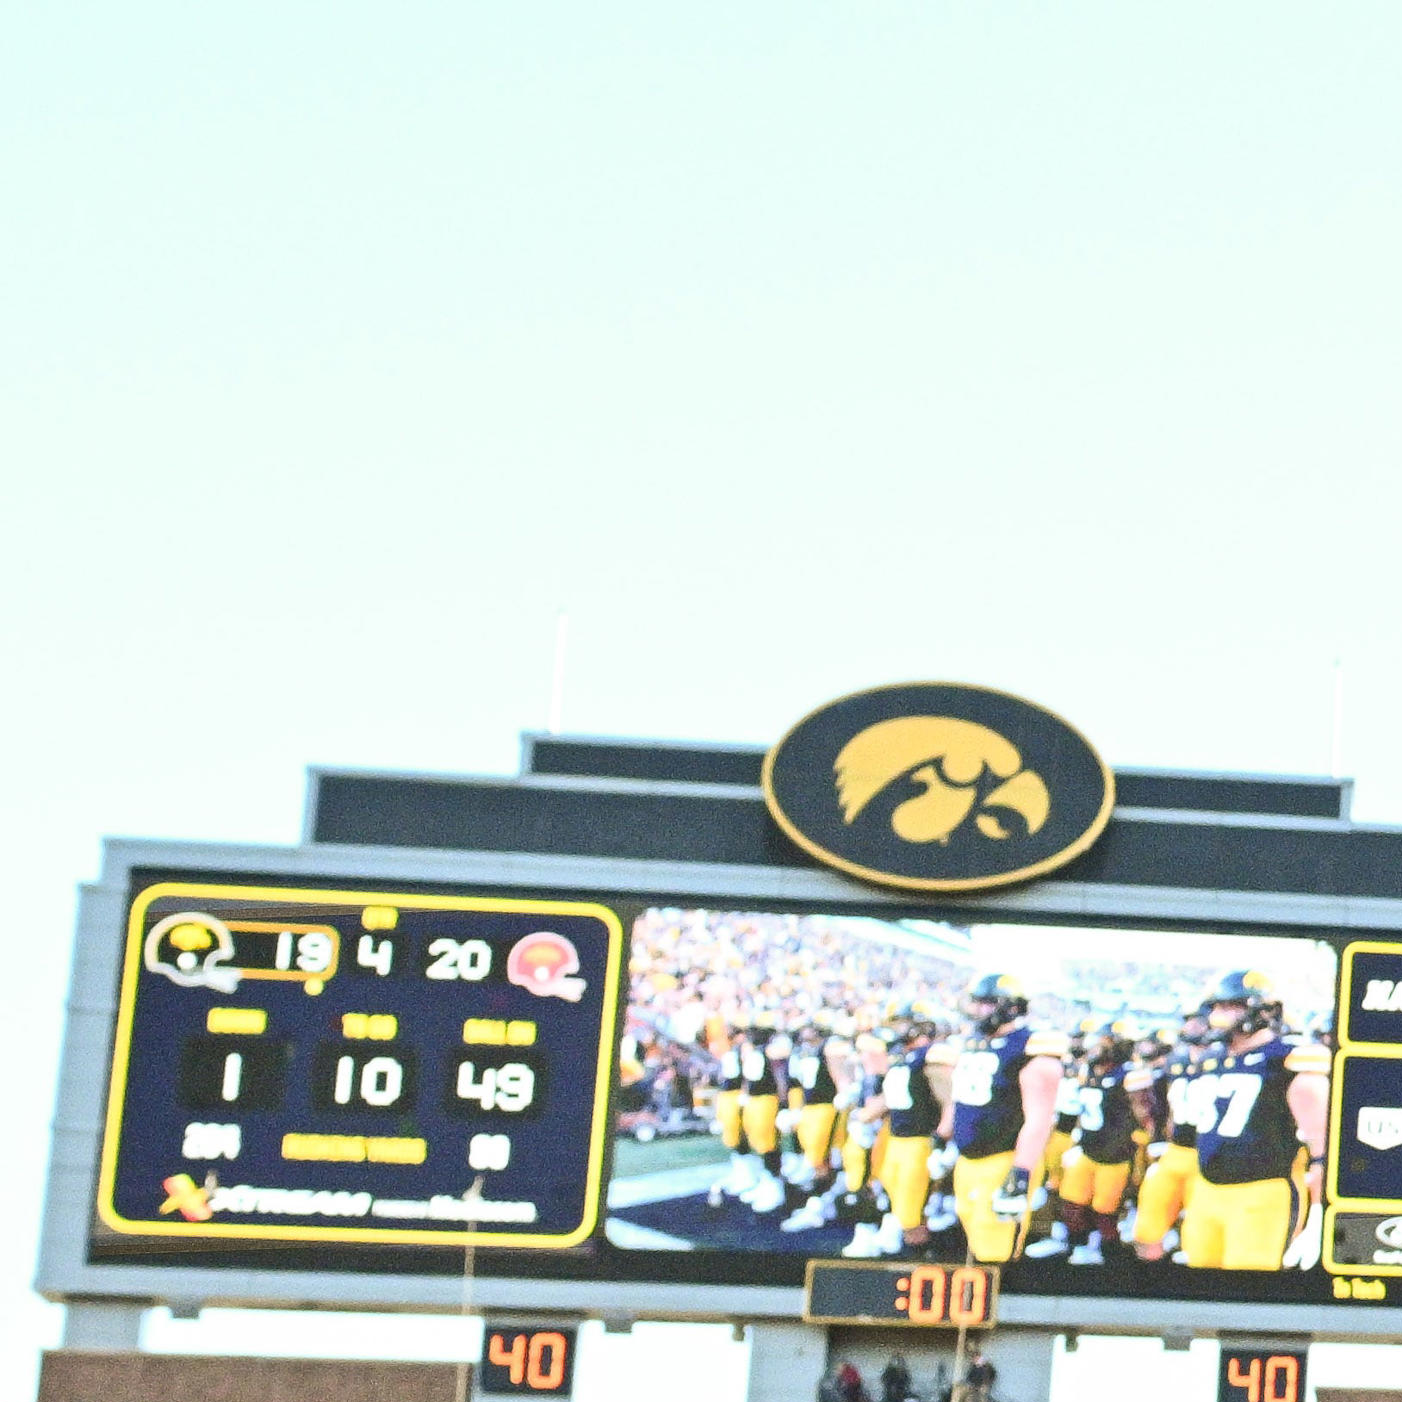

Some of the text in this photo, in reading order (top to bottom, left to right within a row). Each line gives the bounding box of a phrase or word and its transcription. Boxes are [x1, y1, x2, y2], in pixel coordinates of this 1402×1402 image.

[275, 931, 334, 972] 19
[357, 934, 393, 976] 4
[425, 937, 493, 981] 20
[221, 1052, 243, 1101] 1
[334, 1055, 403, 1106] 10
[456, 1060, 536, 1112] 49
[489, 1331, 567, 1390] 40
